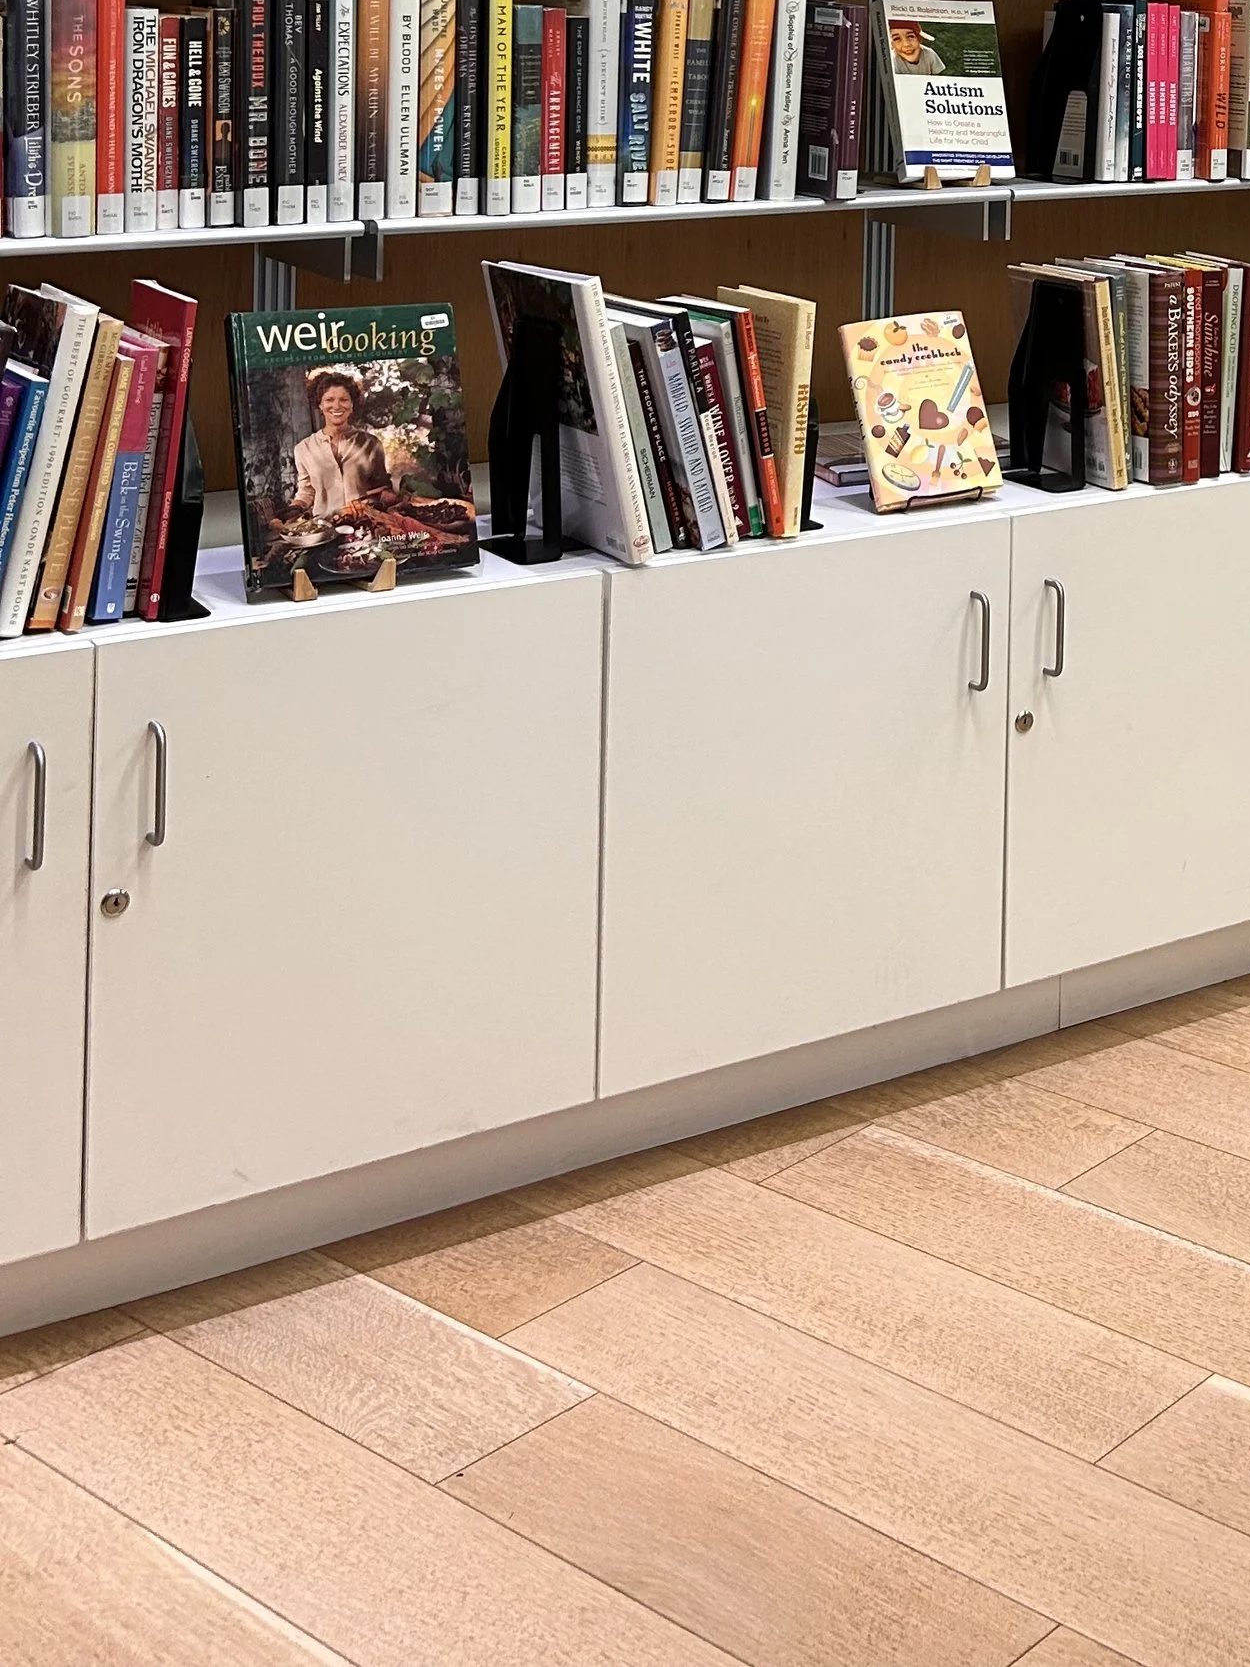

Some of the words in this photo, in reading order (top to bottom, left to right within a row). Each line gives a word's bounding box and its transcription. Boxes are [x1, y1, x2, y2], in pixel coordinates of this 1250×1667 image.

[73, 15, 83, 42] THE
[252, 0, 264, 27] PAUL
[402, 15, 411, 29] BY
[497, 6, 506, 36] MAN
[787, 15, 796, 41] Sophia
[252, 33, 264, 88] THEROUX
[402, 34, 410, 74] BLOOD
[497, 42, 506, 60] OF
[67, 46, 83, 103] SONS
[496, 65, 505, 92] THE
[785, 63, 793, 88] Silicon
[924, 82, 984, 98] Autism
[248, 96, 267, 130] MR.
[401, 85, 410, 121] ELLEN
[496, 97, 505, 131] YEAR
[783, 90, 792, 112] Valley
[925, 100, 1003, 116] Solutions
[1215, 92, 1226, 129] WILD
[248, 136, 267, 184] BONE
[400, 127, 409, 175] ULLMAN
[1170, 295, 1177, 305] a
[1186, 287, 1194, 347] SOUTHERN
[1230, 284, 1239, 329] DROPPING
[257, 312, 345, 353] weir
[326, 322, 436, 356] cooking
[912, 343, 929, 353] the
[1168, 308, 1181, 372] BAKER'S
[1194, 314, 1202, 376] Thompson's
[1204, 312, 1219, 377] Sunshine
[880, 353, 913, 366] candy
[915, 347, 961, 361] cookbook
[1186, 350, 1194, 382] SIDES
[24, 390, 45, 430] Favourite
[1165, 375, 1181, 438] odyssey
[18, 432, 36, 465] Recipes
[13, 467, 28, 487] from
[640, 448, 656, 499] SICHERMAN
[6, 488, 23, 512] Peter
[0, 513, 16, 547] Hudson
